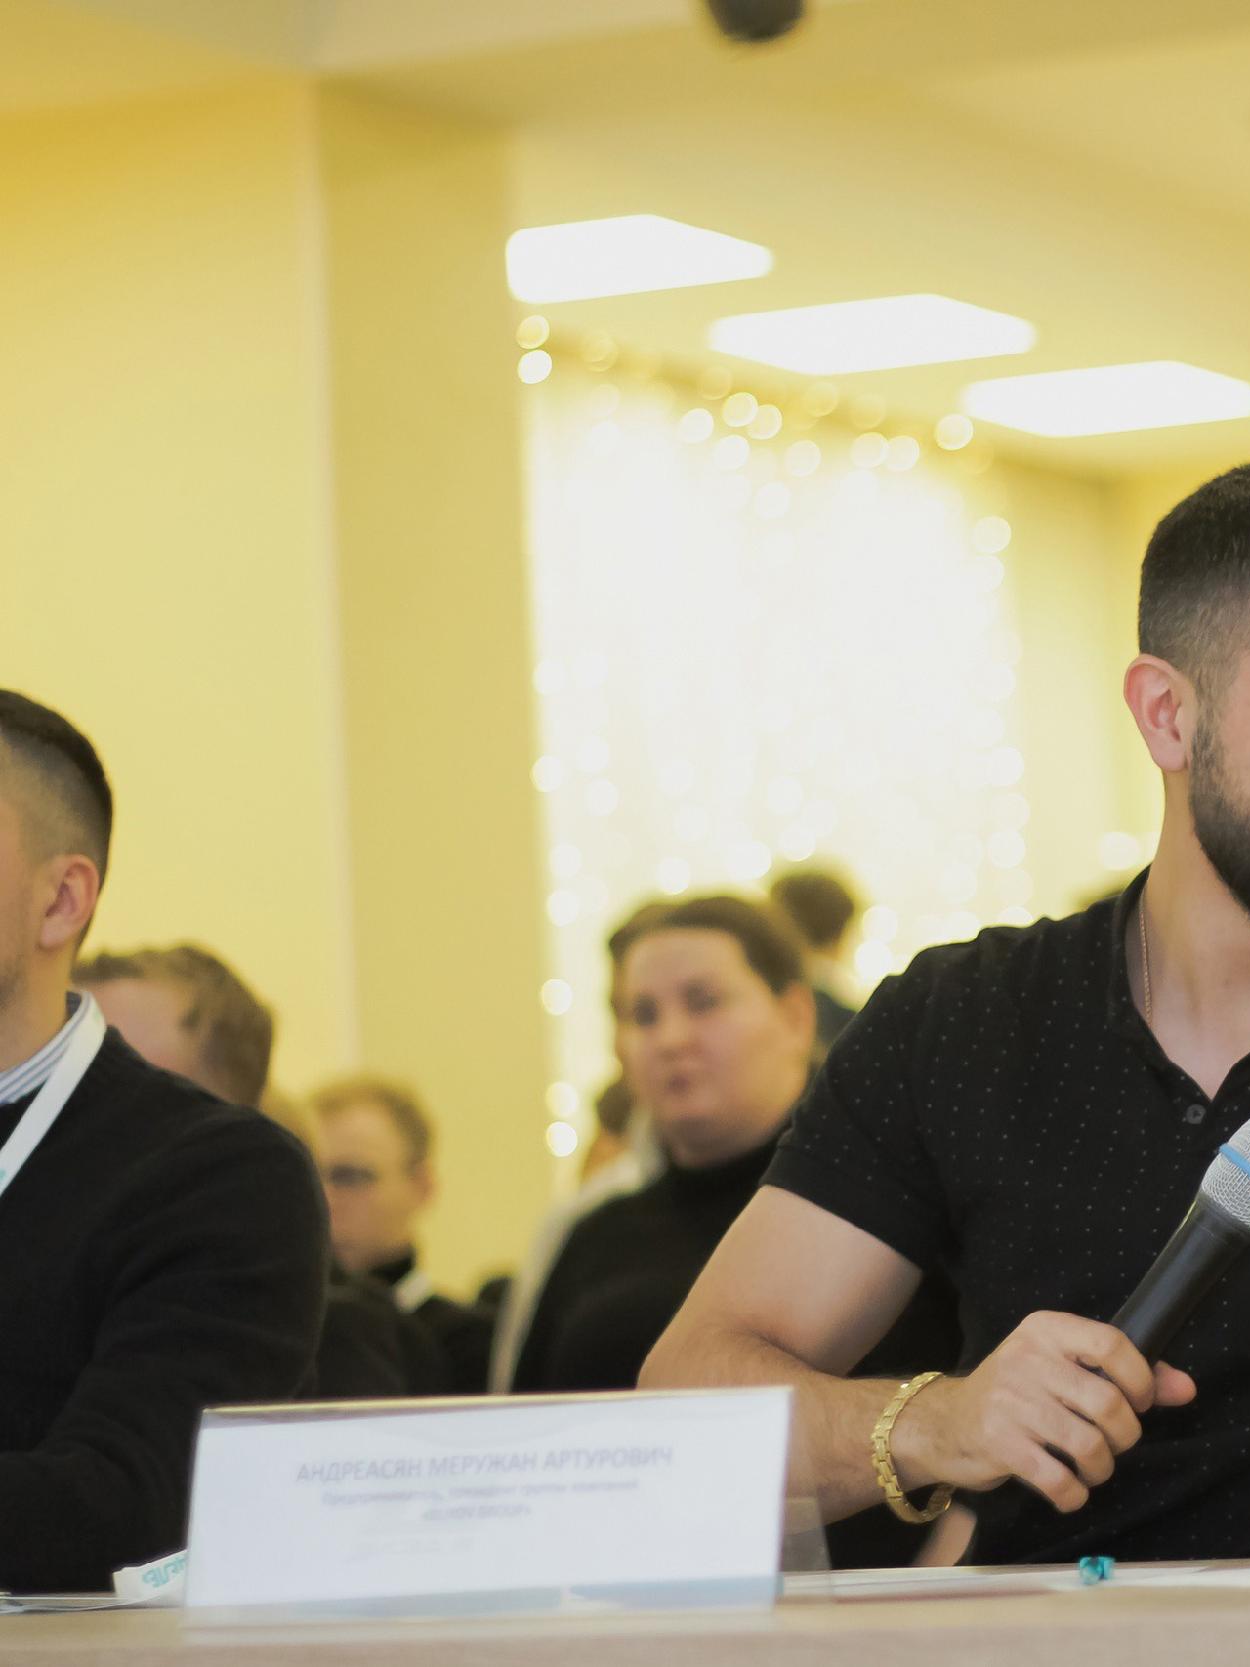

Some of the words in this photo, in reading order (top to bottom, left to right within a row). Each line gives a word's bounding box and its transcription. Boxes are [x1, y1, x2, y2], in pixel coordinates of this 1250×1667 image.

[296, 1458, 422, 1482] АНДРЕАСЯН
[428, 1451, 538, 1477] МЕРУЖАН
[543, 1446, 673, 1471] АРТУРОВИЧ
